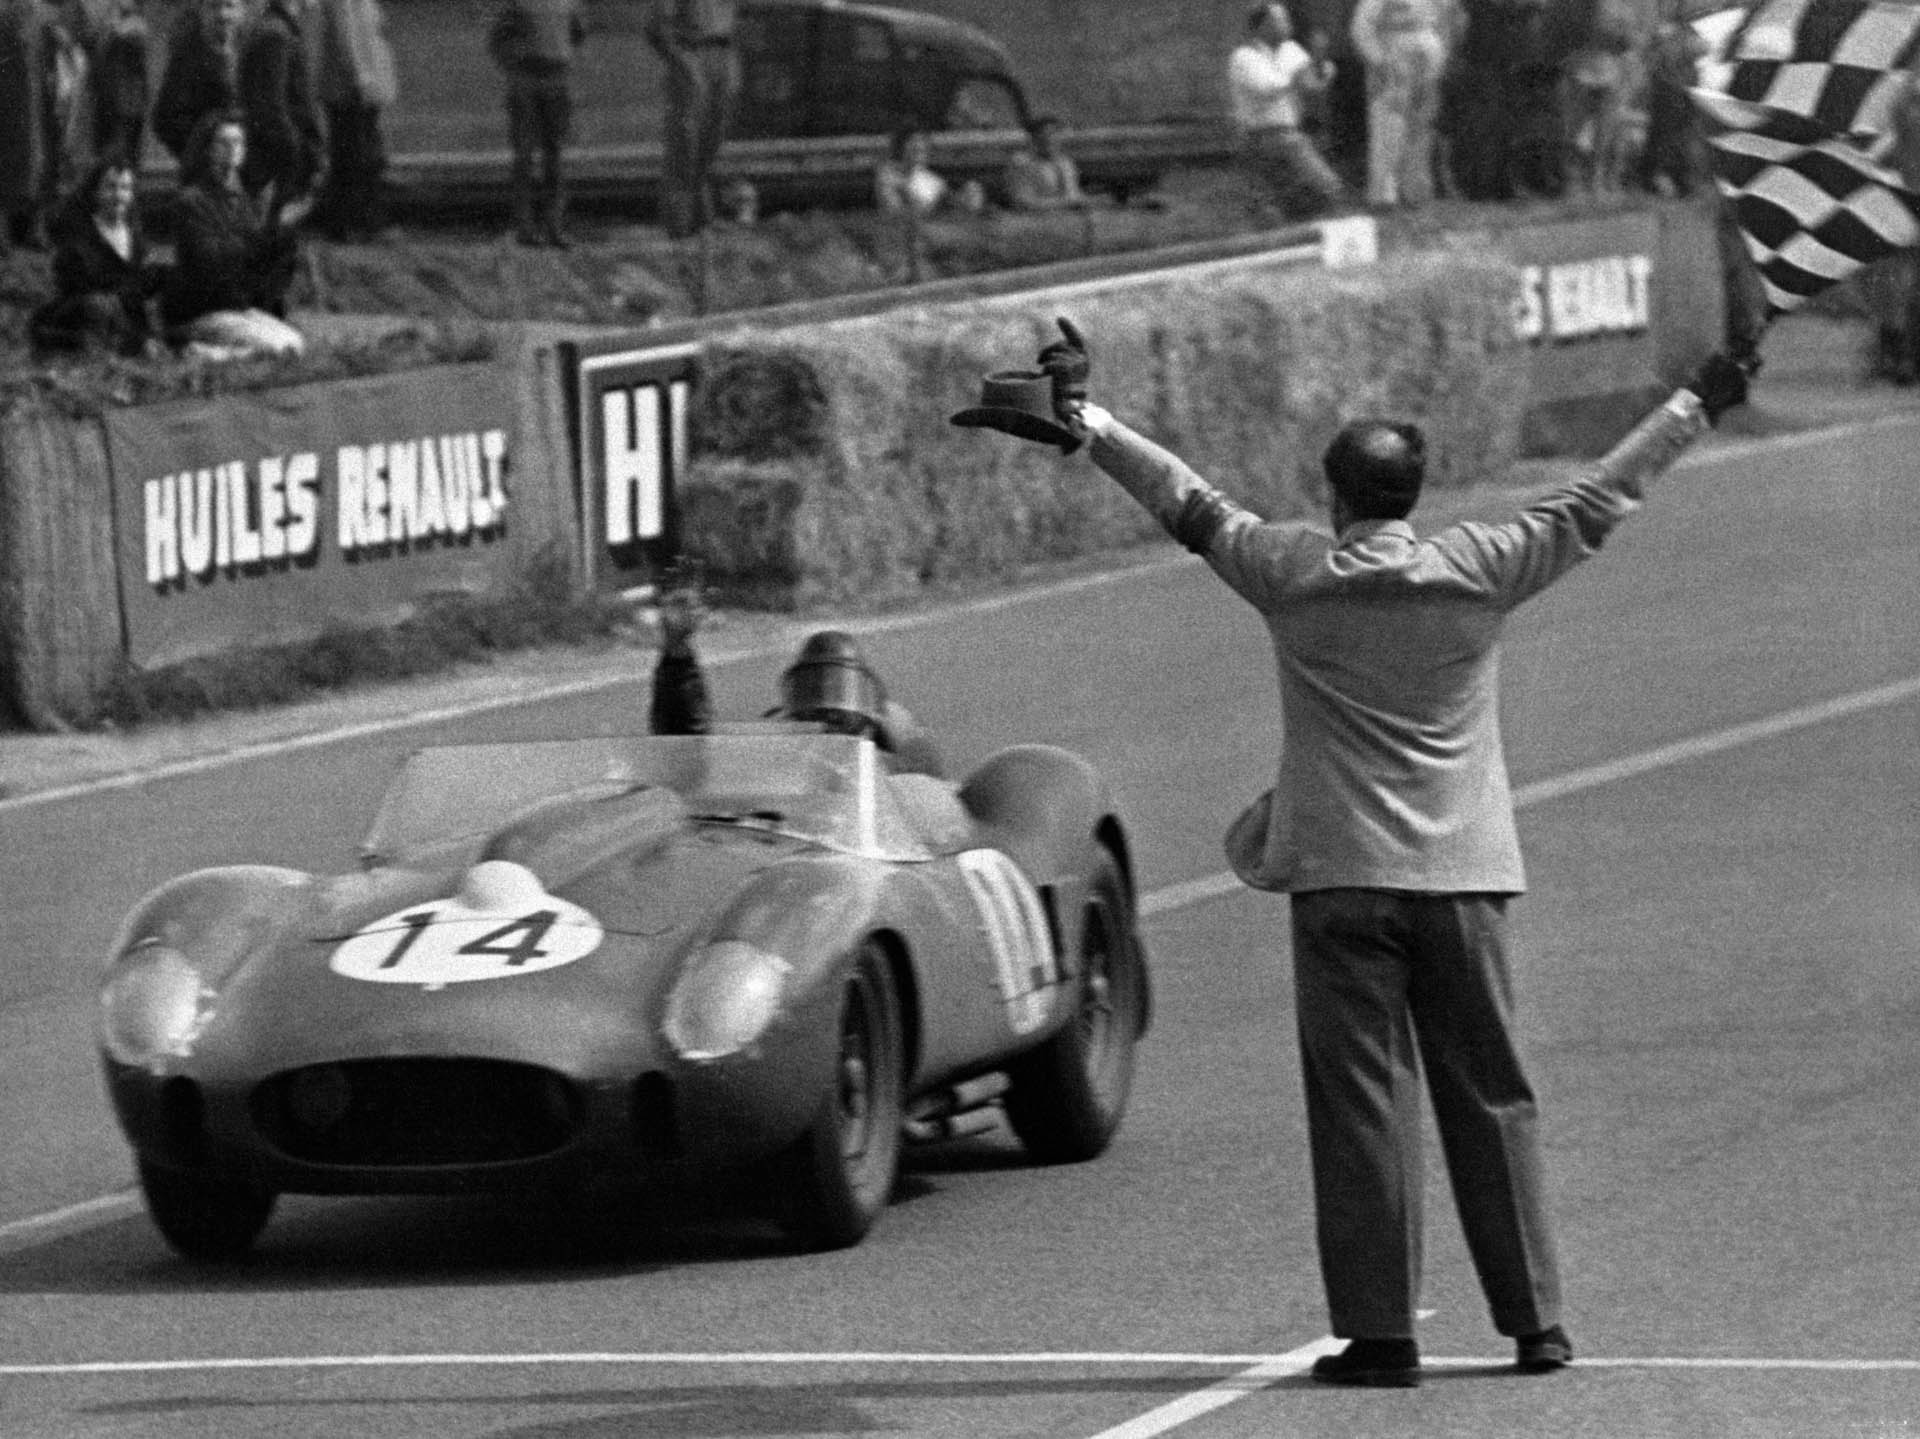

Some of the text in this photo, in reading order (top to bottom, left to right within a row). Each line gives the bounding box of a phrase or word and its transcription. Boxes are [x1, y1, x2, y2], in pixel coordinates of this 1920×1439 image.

[145, 430, 506, 583] HUILES RENAULT
[380, 909, 559, 969] 14
